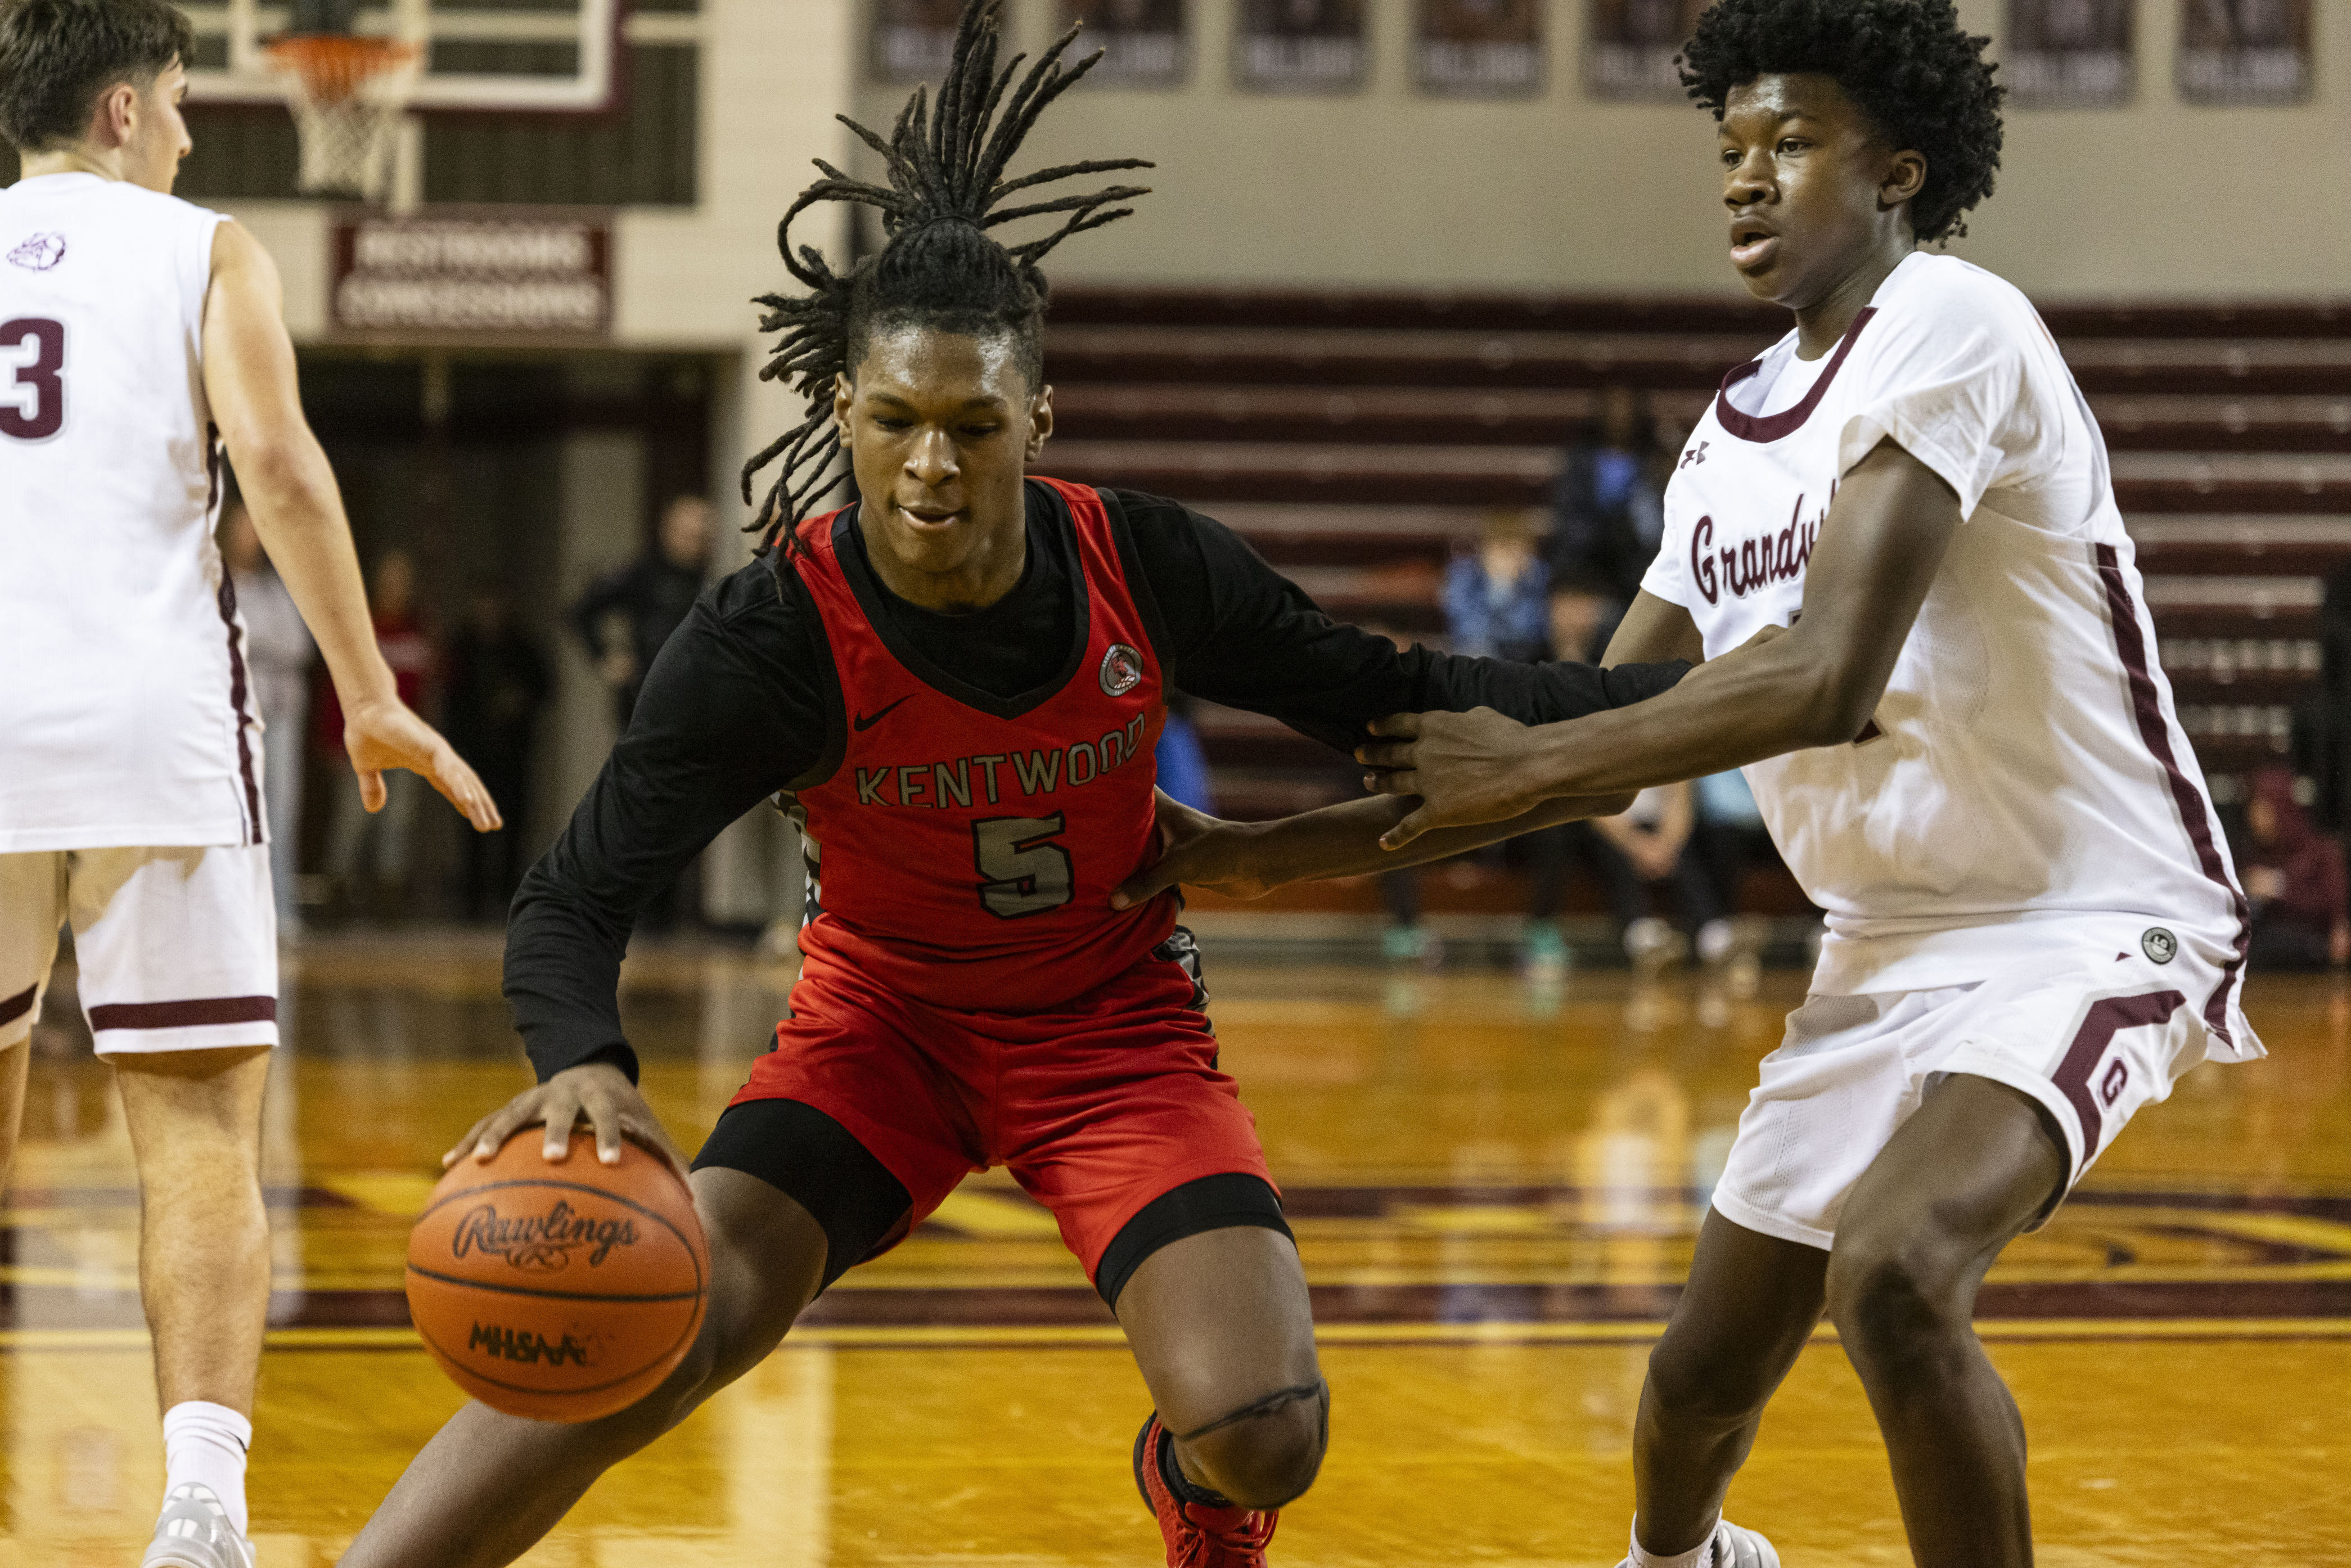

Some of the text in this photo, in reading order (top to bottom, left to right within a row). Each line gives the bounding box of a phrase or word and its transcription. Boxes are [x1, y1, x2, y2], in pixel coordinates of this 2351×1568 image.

[0, 316, 66, 441] 3
[855, 711, 1146, 809] KENTWOOD
[971, 810, 1075, 920] 5
[452, 1199, 639, 1268] Rawlings
